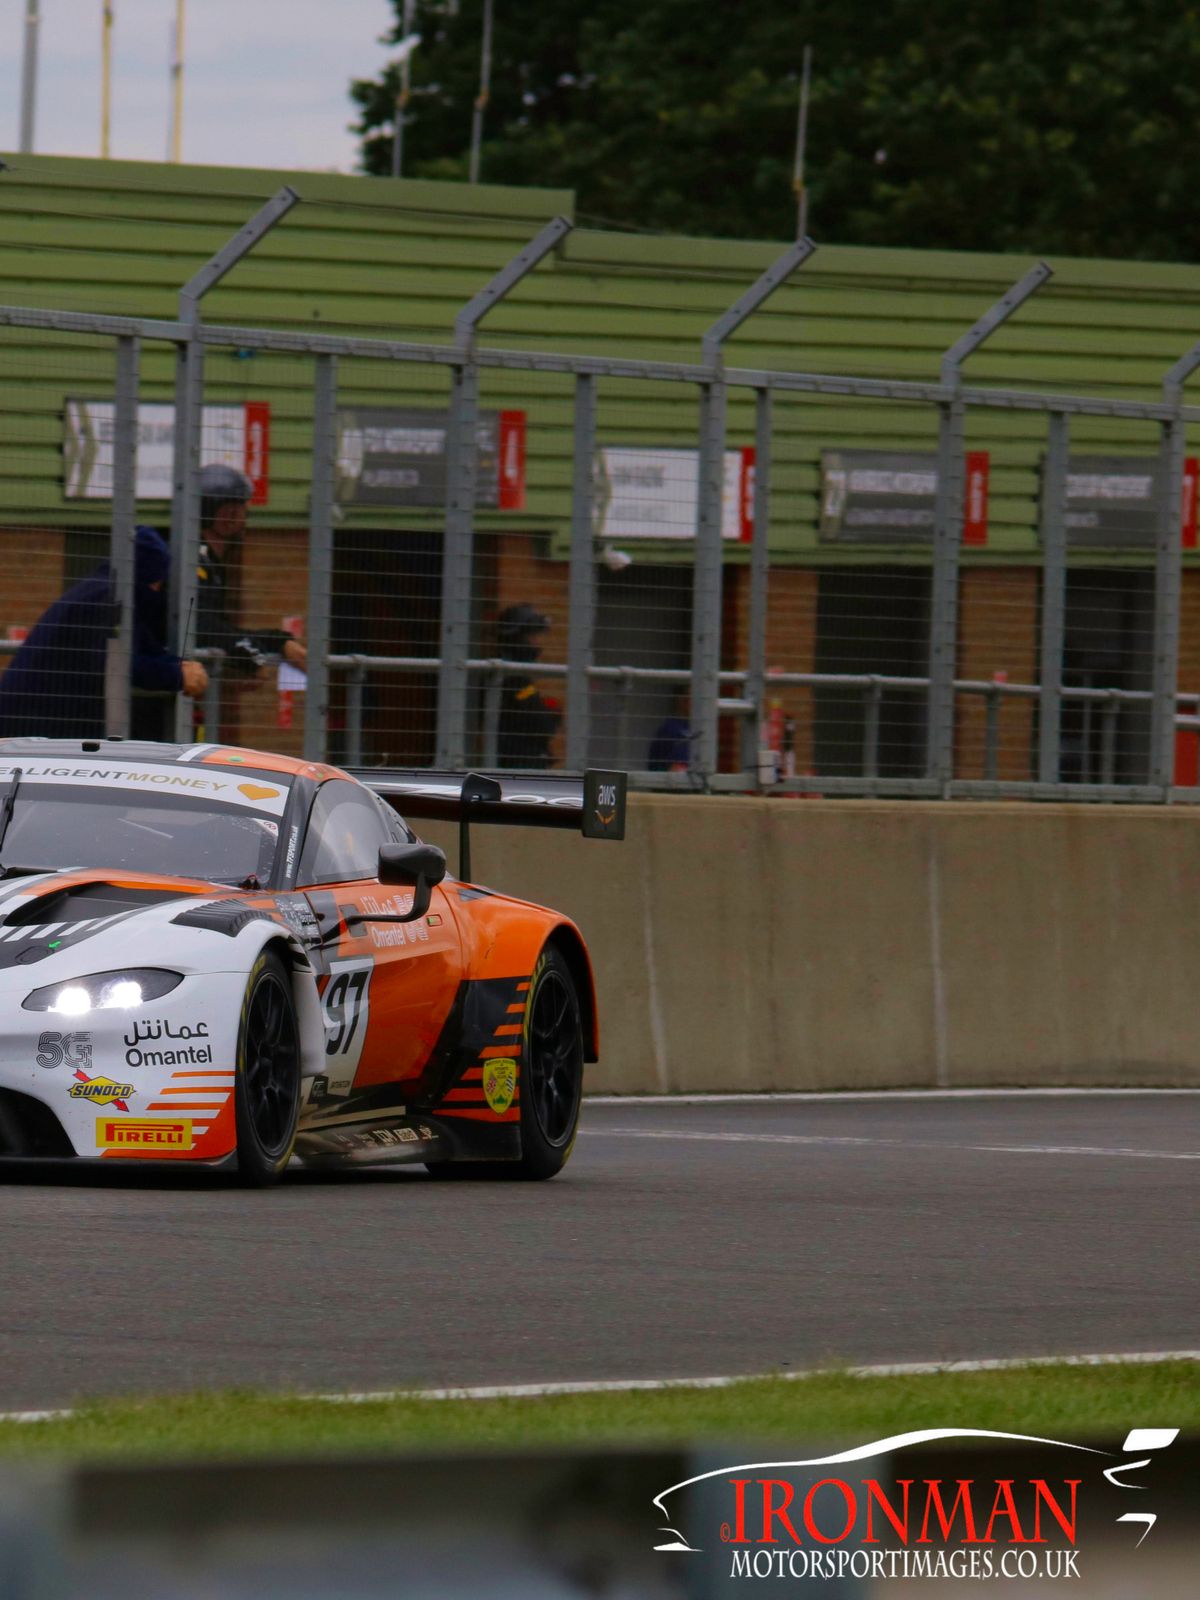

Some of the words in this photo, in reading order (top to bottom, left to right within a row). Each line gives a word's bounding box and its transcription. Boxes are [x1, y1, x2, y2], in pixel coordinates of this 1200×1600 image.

[598, 784, 617, 807] aws
[325, 971, 370, 1055] 97
[36, 1031, 93, 1069] 5G
[125, 1044, 213, 1068] Omantel
[73, 1084, 132, 1097] SUNOCO
[105, 1122, 184, 1143] PIRELLI
